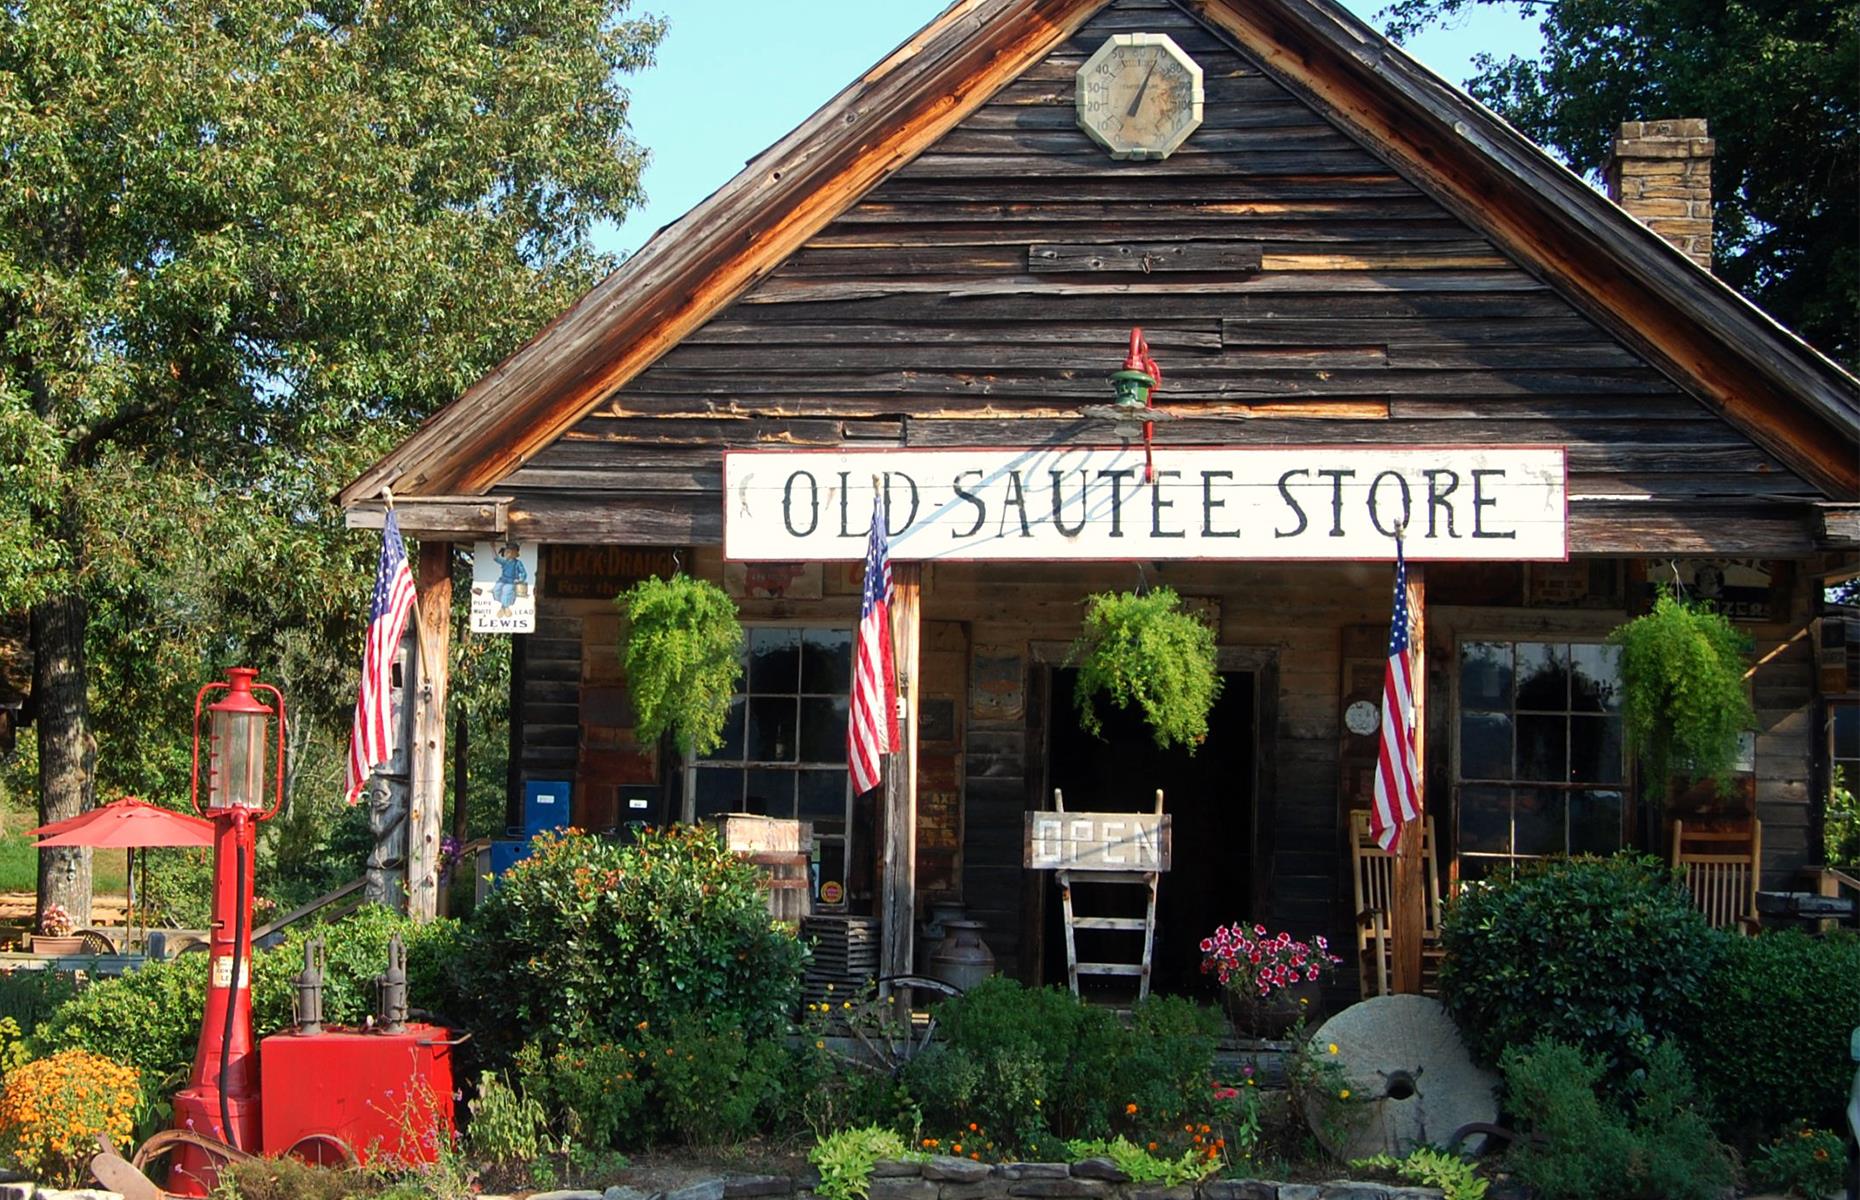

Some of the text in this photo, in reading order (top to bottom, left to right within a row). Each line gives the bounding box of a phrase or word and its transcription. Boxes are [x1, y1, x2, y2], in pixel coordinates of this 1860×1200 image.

[1096, 64, 1109, 75] 40
[1170, 63, 1183, 74] 80
[1088, 83, 1100, 93] 30
[1088, 103, 1100, 113] 20
[1096, 121, 1108, 132] 10
[782, 470, 920, 538] OLD
[952, 469, 1241, 539] SAUTEE
[1275, 468, 1516, 539] STORE
[478, 617, 528, 629] LEWIS
[1038, 820, 1158, 863] OPEN
